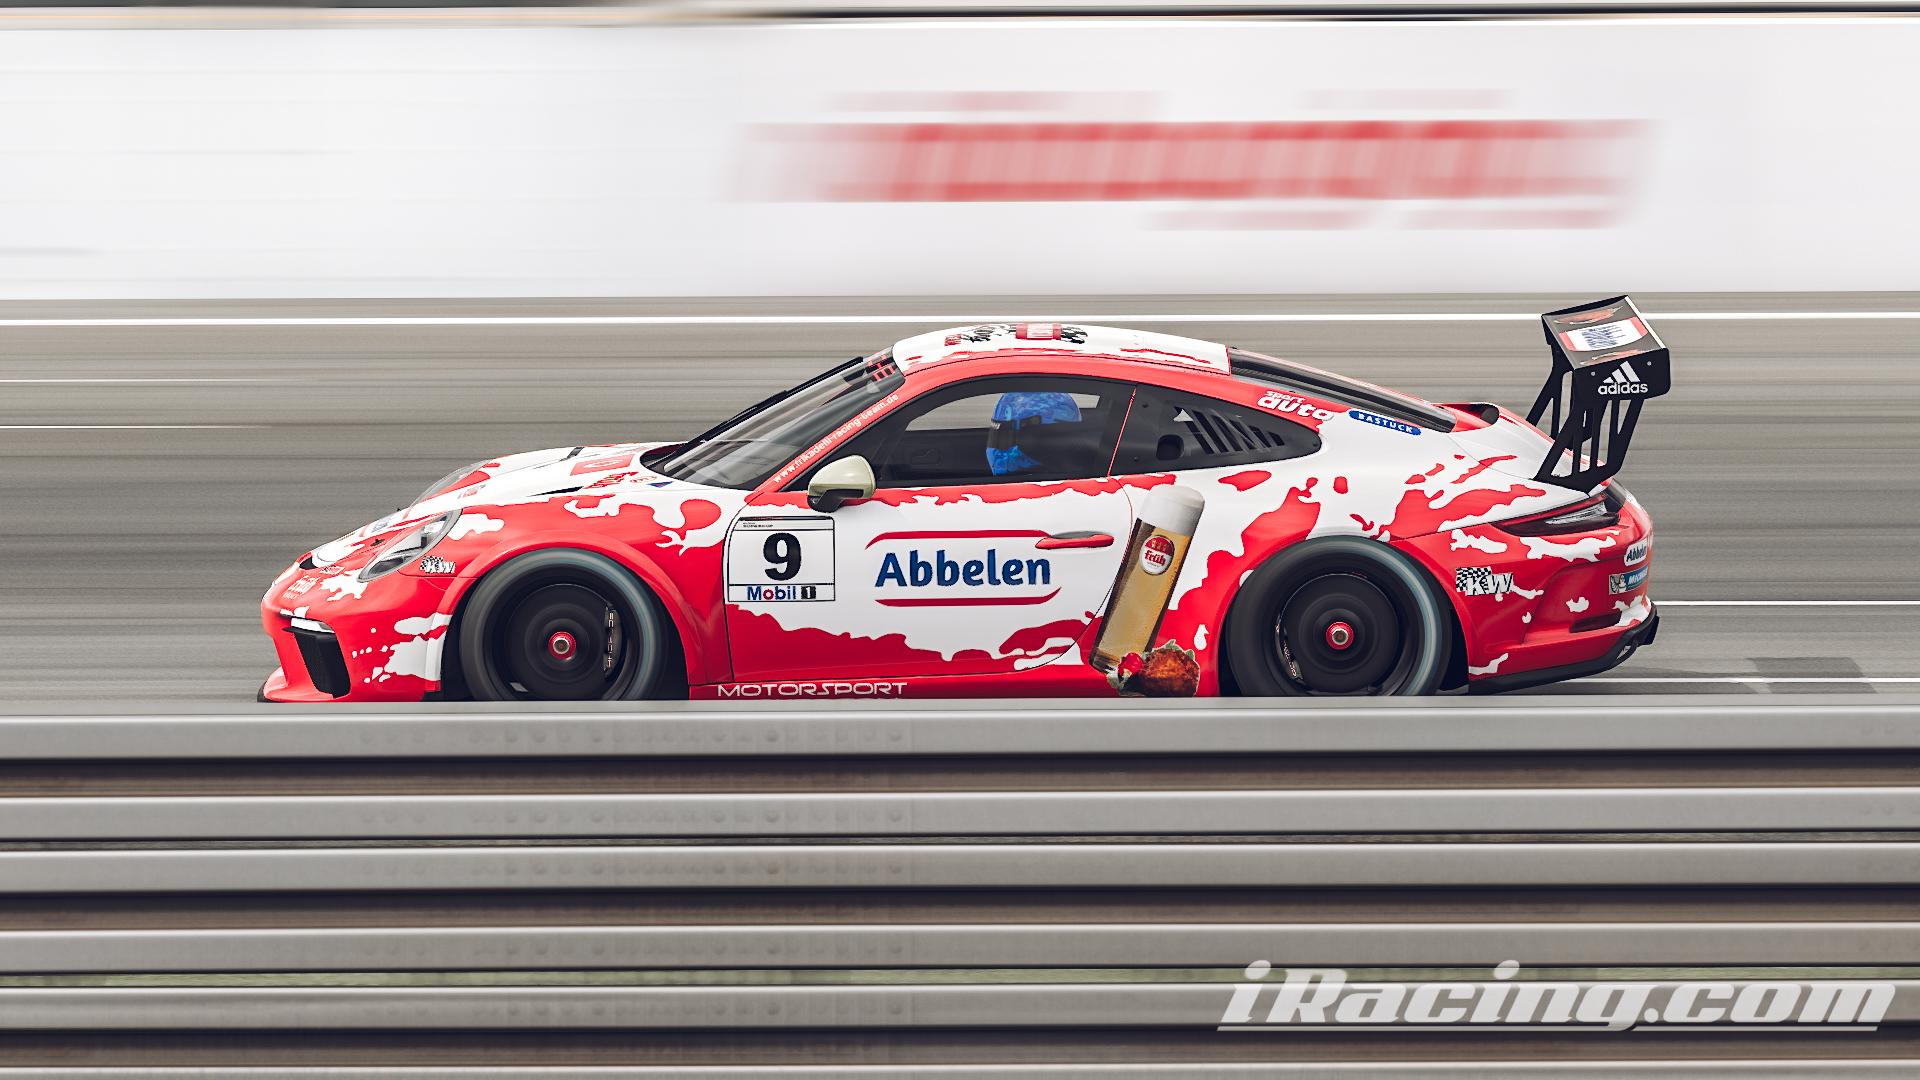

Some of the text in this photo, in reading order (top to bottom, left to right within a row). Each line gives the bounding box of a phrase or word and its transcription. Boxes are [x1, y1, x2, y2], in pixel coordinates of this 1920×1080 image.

[1597, 381, 1649, 395] adidas
[1257, 396, 1334, 421] auto
[1357, 412, 1414, 434] BASTUCK
[762, 532, 802, 581] 9
[874, 548, 1051, 588] Abbelen
[747, 585, 816, 601] Mobil 1
[1463, 571, 1514, 597] KW
[717, 682, 908, 697] MOTORSPORT
